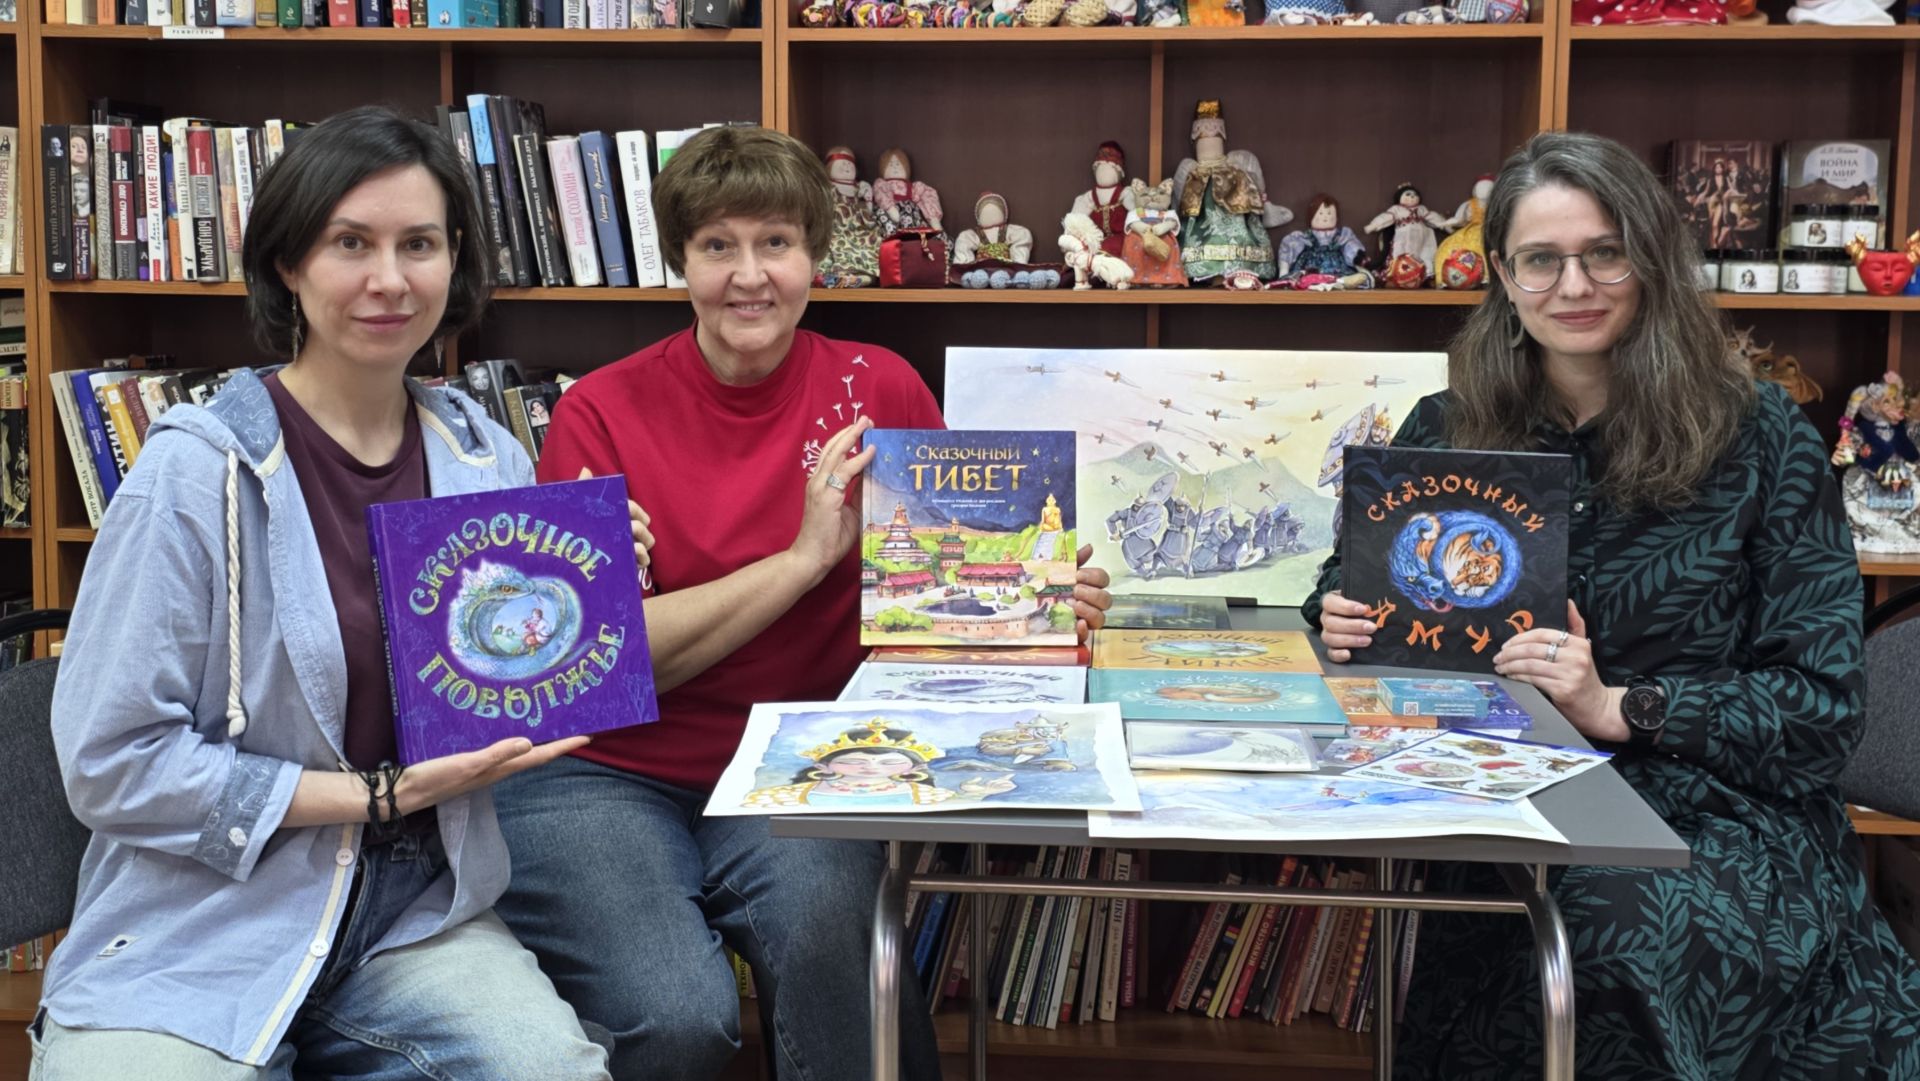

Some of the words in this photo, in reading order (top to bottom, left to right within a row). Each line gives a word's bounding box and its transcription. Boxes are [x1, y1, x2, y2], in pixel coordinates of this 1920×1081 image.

[146, 134, 157, 171] ЛЮДИ!
[1819, 157, 1859, 168] ВОЙНА
[148, 175, 159, 209] КАКИЕ
[564, 171, 581, 215] СОЛОМИН
[1832, 169, 1856, 177] МИР
[635, 189, 651, 237] ТАБАКОВ
[198, 220, 215, 272] БОНДАРЧУК
[643, 242, 656, 270] ОЛЕГ
[916, 444, 1021, 461] Сказочный
[81, 469, 93, 500] ВОКАЛА
[908, 464, 1028, 493] ТИБЕТ
[1367, 474, 1545, 533] СКАЗОЧНЫЙ
[409, 512, 613, 616] СКАЗОЧНОЕ
[1364, 597, 1534, 655] АМУР
[416, 623, 626, 727] ПОВОЛЖЬЕ
[1246, 920, 1270, 966] ИСКУССТВО
